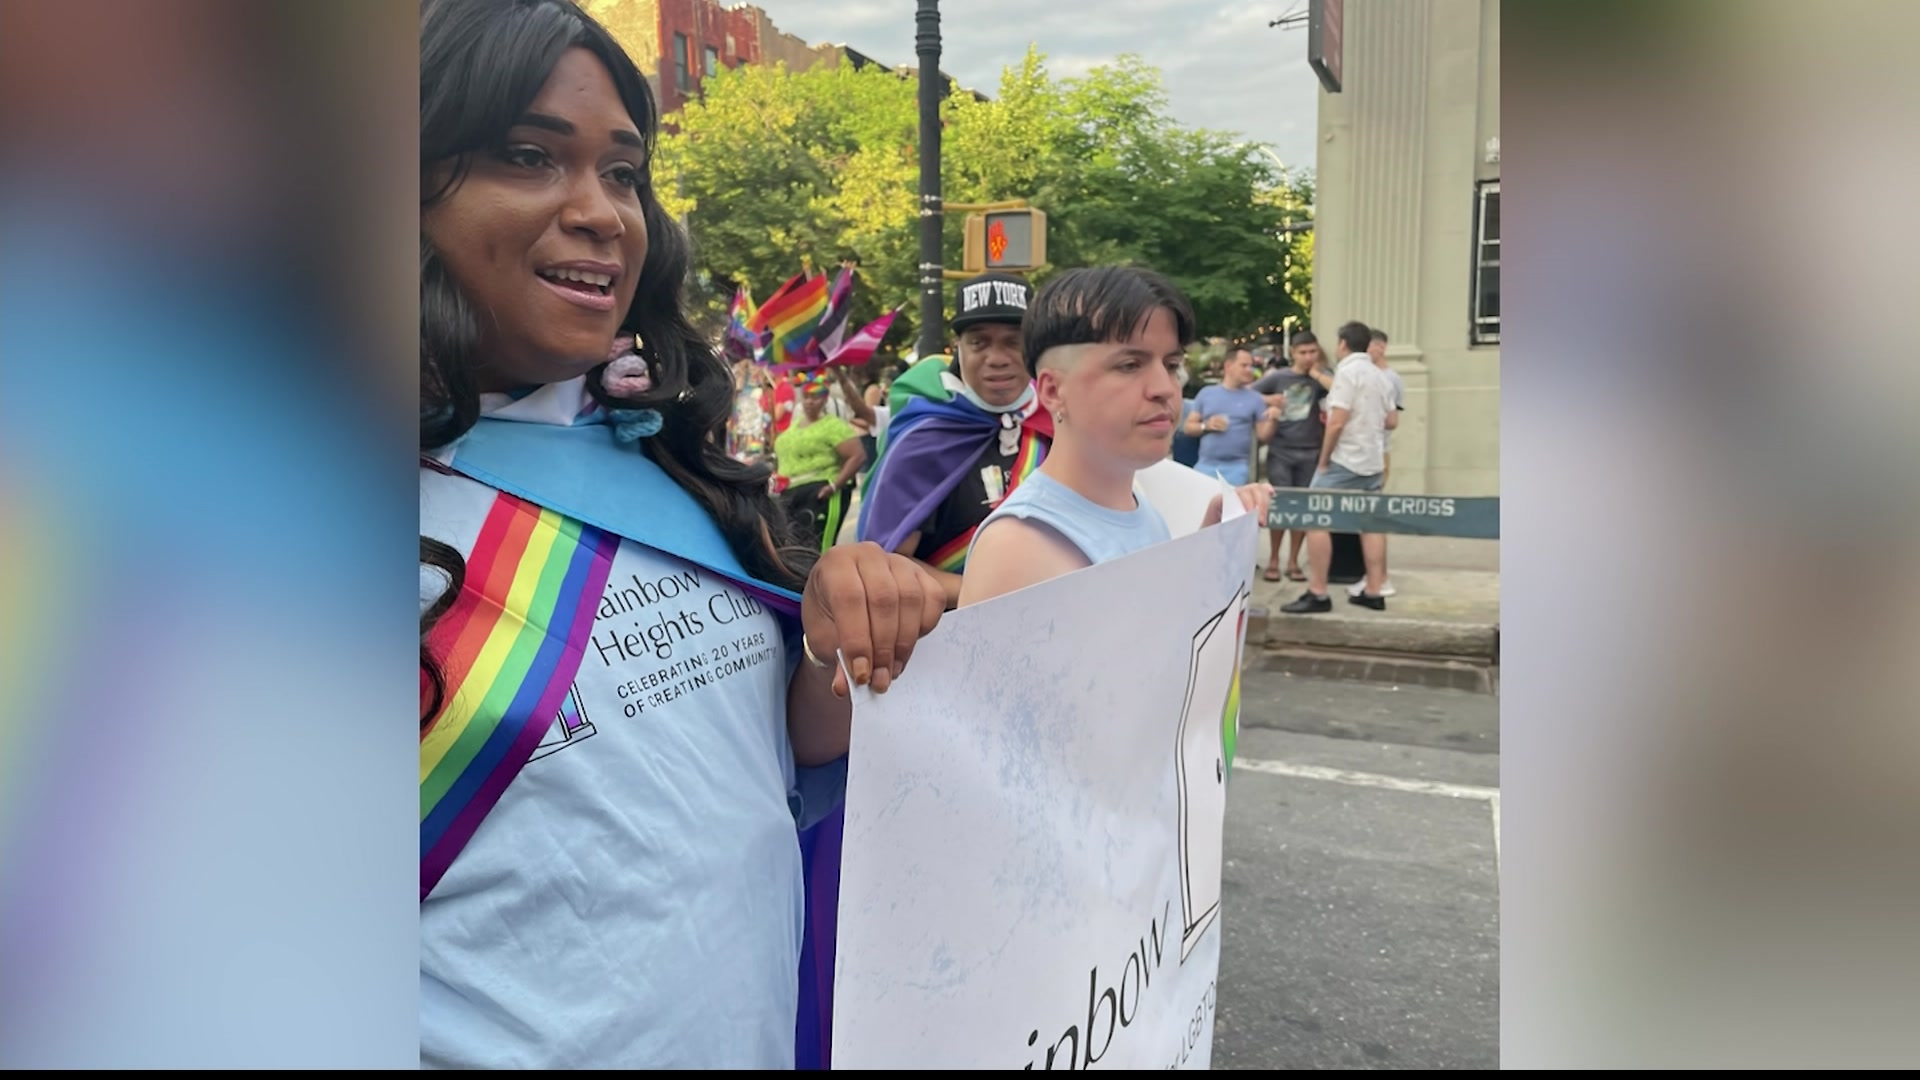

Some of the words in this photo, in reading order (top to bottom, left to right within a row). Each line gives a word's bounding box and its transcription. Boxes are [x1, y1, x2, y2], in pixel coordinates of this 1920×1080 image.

[963, 281, 992, 312] NEW
[992, 280, 1027, 310] YORK
[1269, 512, 1332, 526] NYPD
[1308, 494, 1333, 511] DO
[1340, 496, 1380, 513] NOT
[1387, 497, 1456, 517] CROSS
[595, 568, 701, 621] ainbow
[591, 610, 704, 667] Heights
[708, 589, 762, 625] Club
[617, 652, 709, 699] CELEBRATING
[711, 644, 729, 662] 20
[731, 632, 766, 653] YEARS
[624, 699, 645, 718] OF
[647, 670, 714, 708] CREATING
